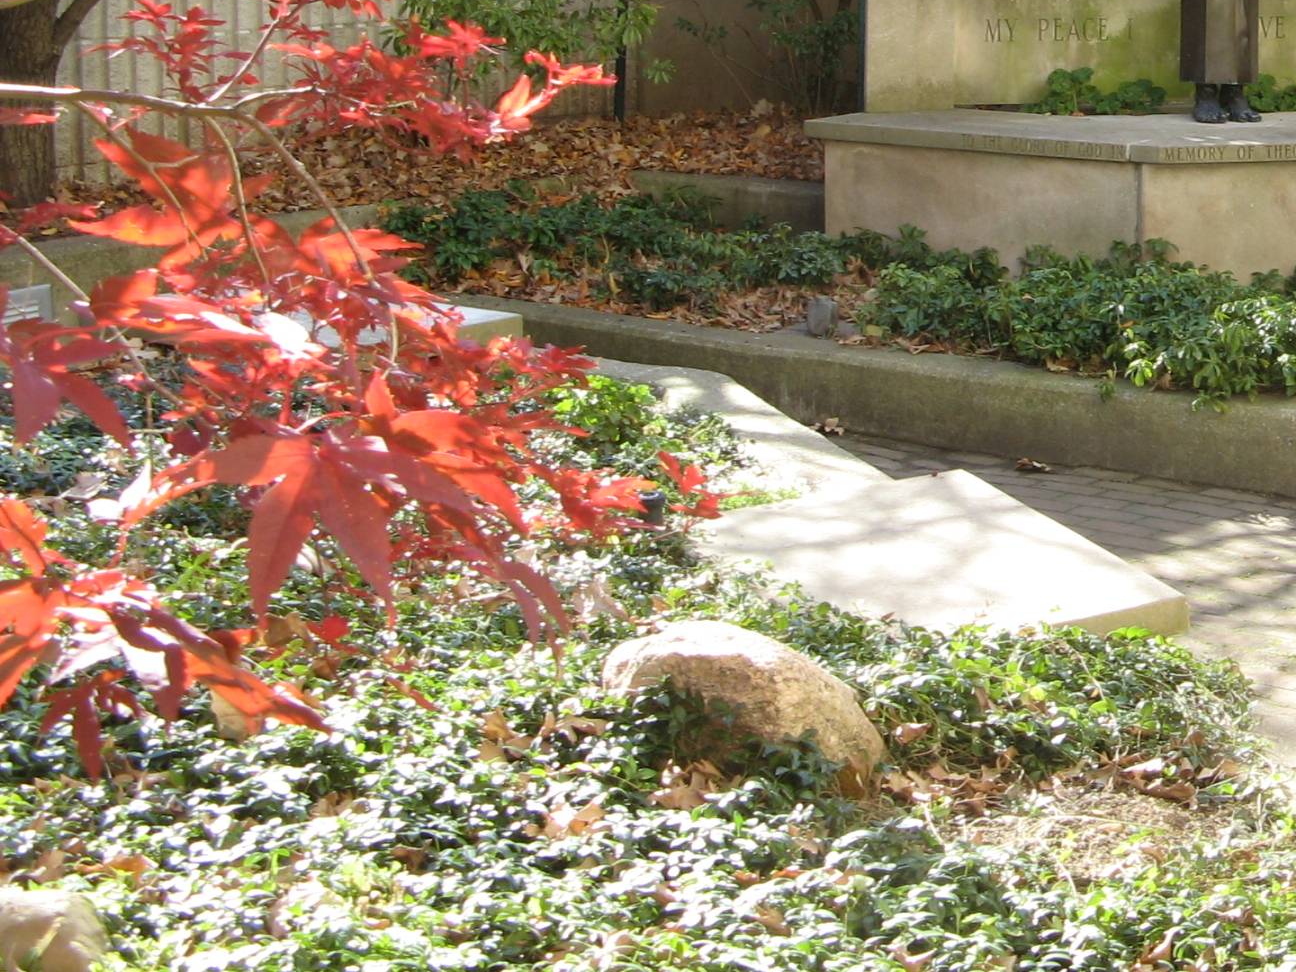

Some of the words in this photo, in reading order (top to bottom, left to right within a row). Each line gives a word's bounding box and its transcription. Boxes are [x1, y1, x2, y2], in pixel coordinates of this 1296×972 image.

[985, 18, 1017, 43] MY
[1038, 17, 1109, 42] PEACE
[1127, 18, 1134, 40] I
[1259, 15, 1285, 39] VE
[1164, 147, 1226, 161] MEMORY
[1237, 145, 1254, 160] OF
